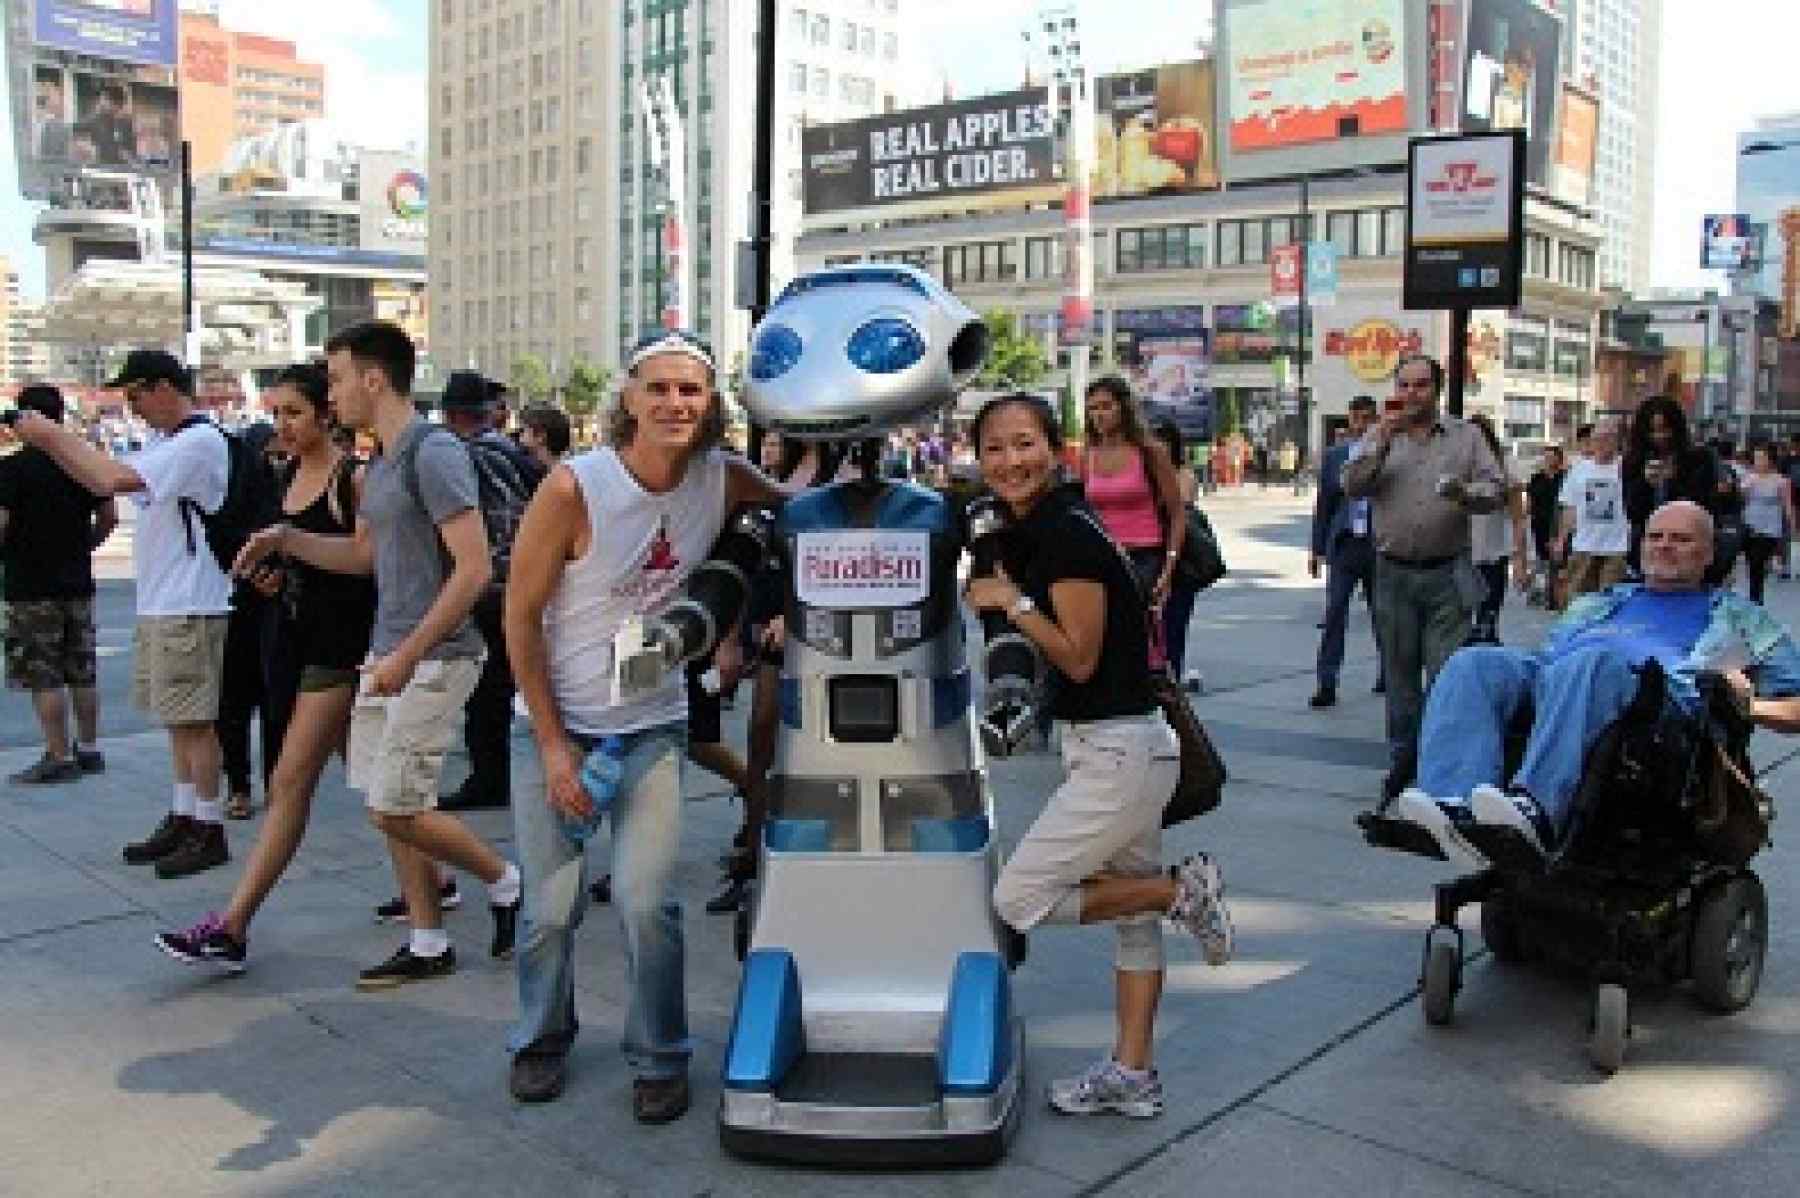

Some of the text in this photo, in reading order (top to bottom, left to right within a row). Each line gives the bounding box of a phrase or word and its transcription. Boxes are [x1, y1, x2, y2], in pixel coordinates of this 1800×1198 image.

[869, 103, 1054, 160] REAL APPLES
[873, 158, 940, 199] REAL
[947, 147, 1037, 186] CIDER.
